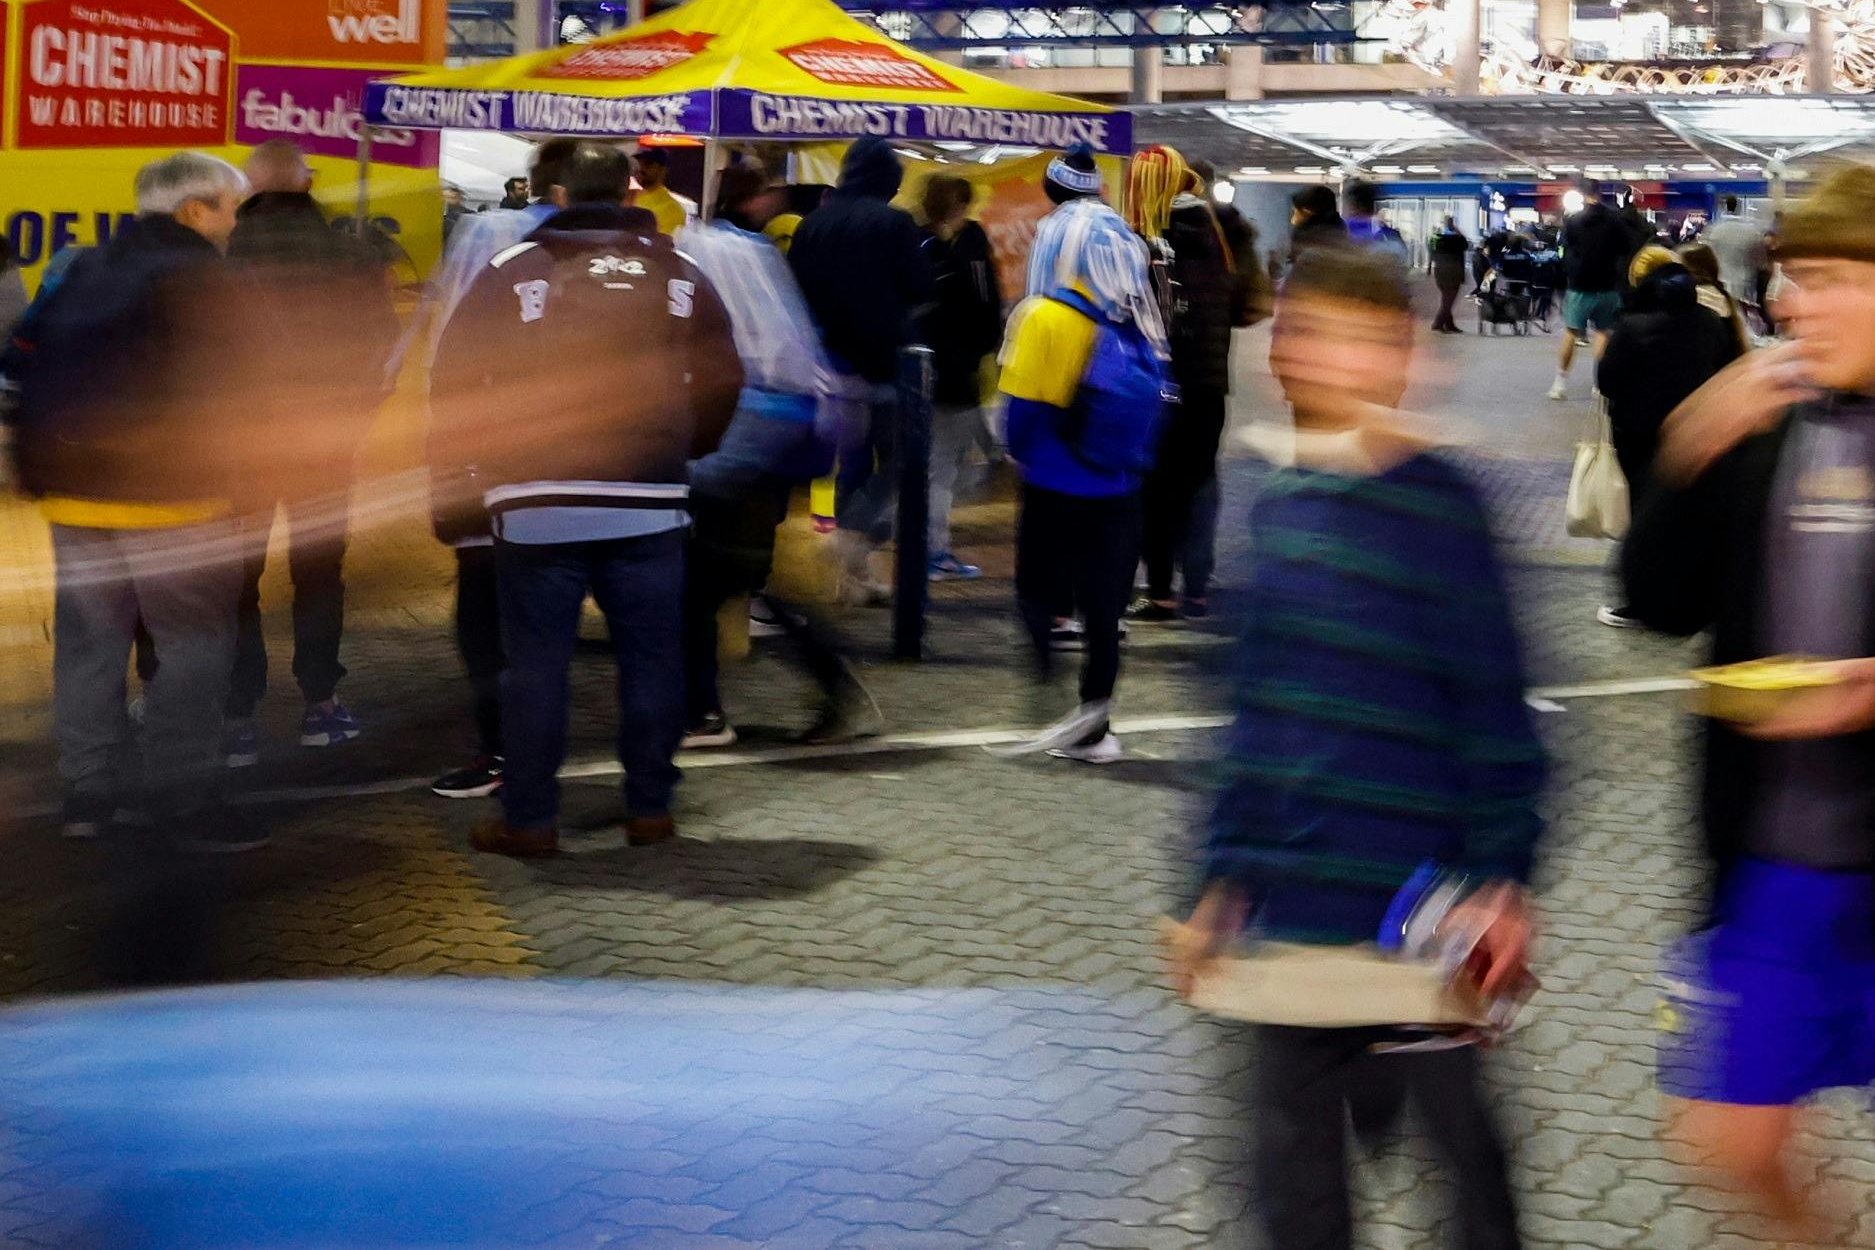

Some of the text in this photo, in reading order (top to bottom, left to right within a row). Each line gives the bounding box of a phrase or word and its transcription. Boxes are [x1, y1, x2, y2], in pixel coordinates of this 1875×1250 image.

[30, 23, 225, 96] CHEMIST
[28, 95, 219, 129] WAREHOUSE
[381, 86, 506, 127] CHEMIST
[511, 90, 691, 134] WAREHOUSE
[752, 94, 1109, 148] CHEMIST WAREHOUSE
